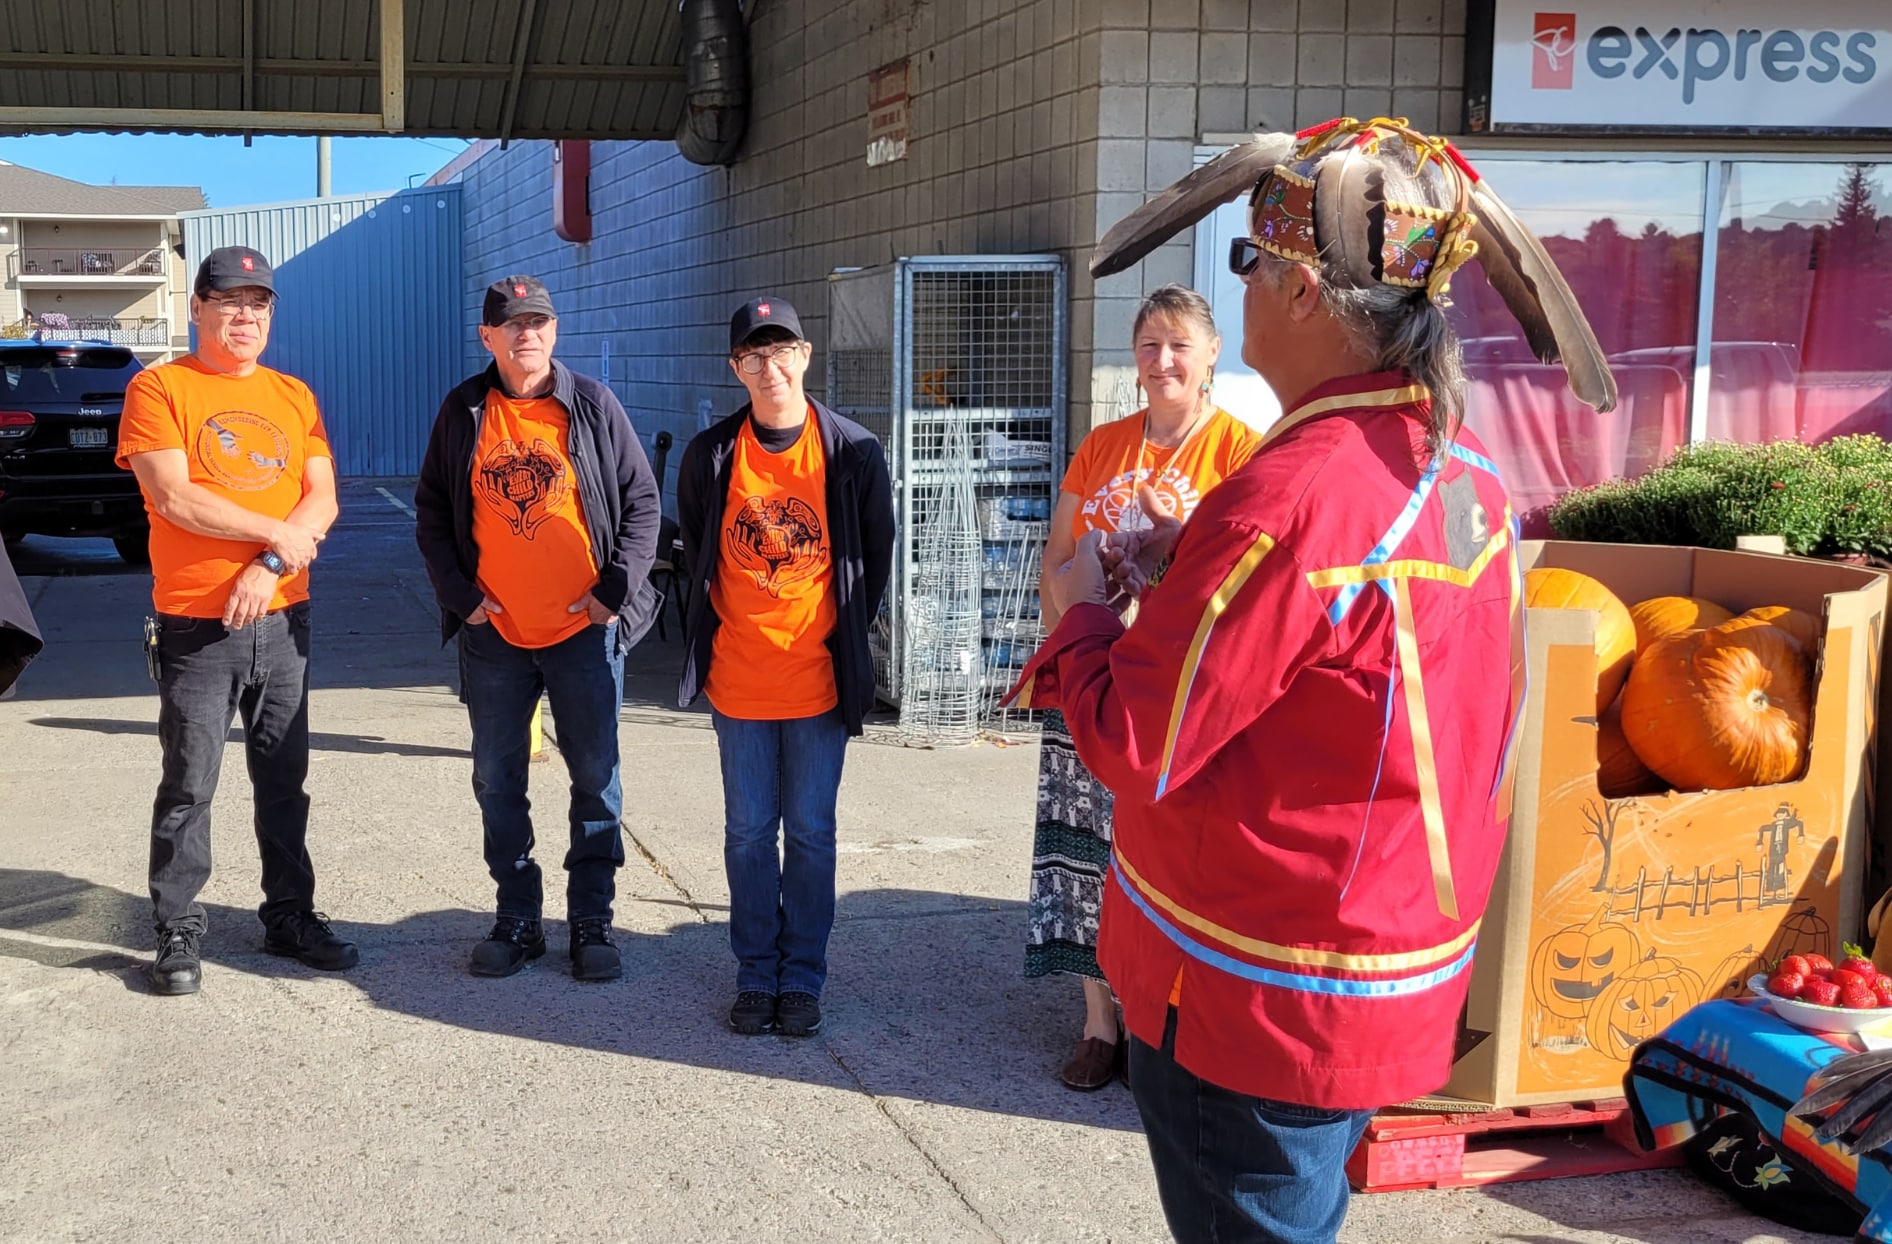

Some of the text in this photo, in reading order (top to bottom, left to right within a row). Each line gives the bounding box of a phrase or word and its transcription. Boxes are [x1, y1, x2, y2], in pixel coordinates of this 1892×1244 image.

[1586, 25, 1877, 105] express
[78, 407, 102, 416] Jeep
[507, 479, 533, 495] CHILD
[759, 540, 787, 554] CHILD
